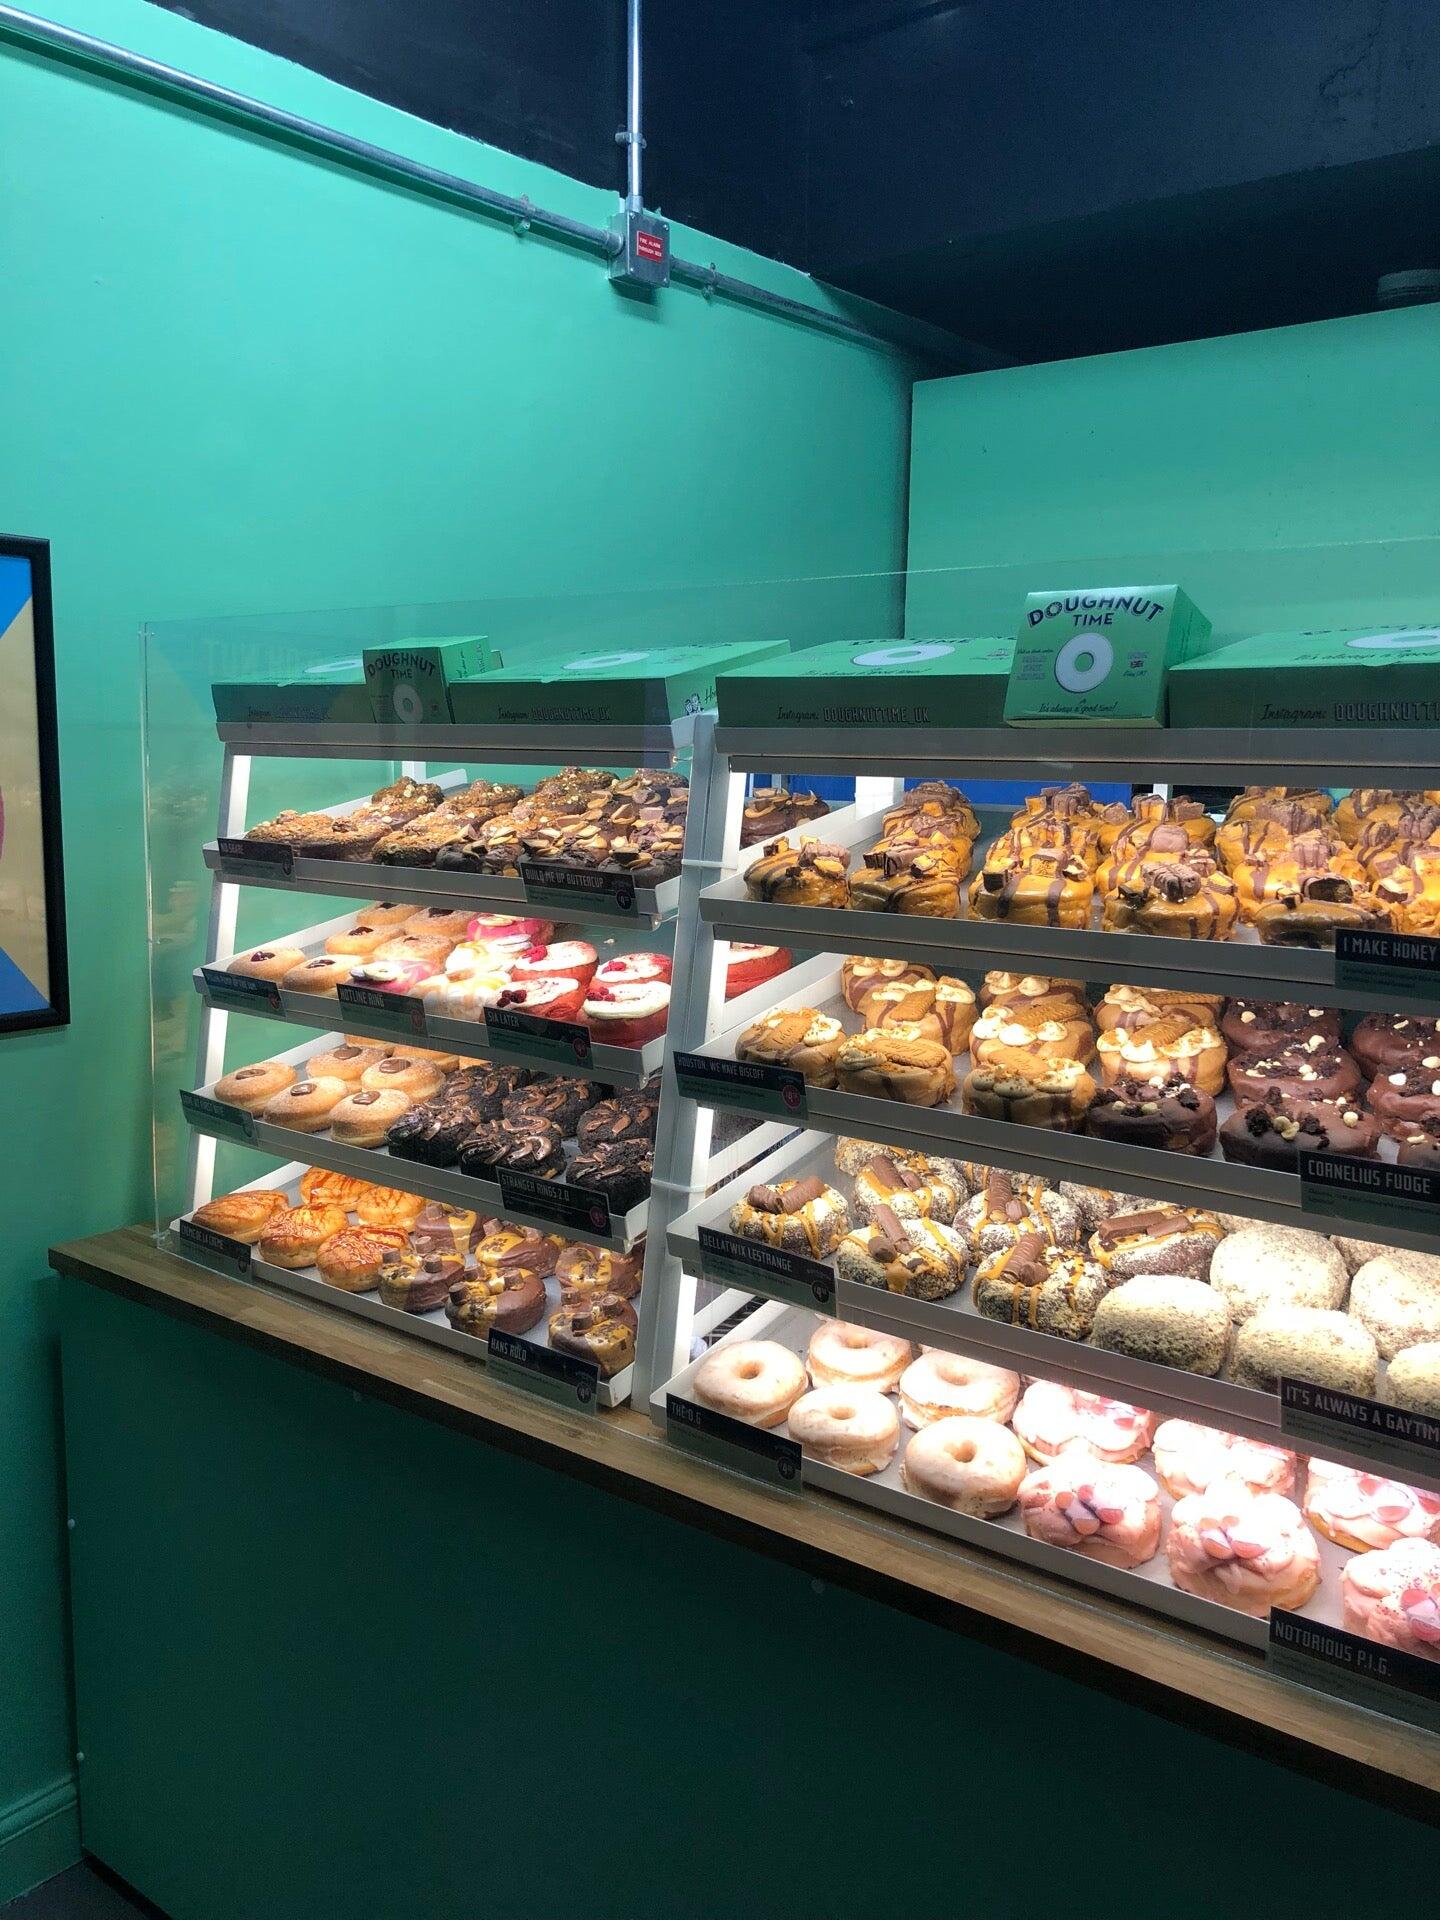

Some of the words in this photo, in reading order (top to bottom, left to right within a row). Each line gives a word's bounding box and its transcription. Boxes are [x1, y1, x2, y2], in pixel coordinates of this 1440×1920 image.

[1027, 595, 1164, 628] DOUGHNUT
[1073, 613, 1114, 627] TIME
[367, 652, 436, 677] DOUGHNUT
[391, 668, 413, 679] TIME
[567, 874, 604, 889] BUTTERCUP
[1343, 937, 1348, 952] I
[1352, 938, 1388, 957] MAKE
[1392, 941, 1438, 961] HONEY
[499, 1012, 520, 1028] LATER
[710, 1062, 720, 1073] WE
[501, 1174, 536, 1193] STRANGER
[1308, 1160, 1381, 1186] CORNELIUS
[1385, 1172, 1431, 1194] FUDGE
[703, 1234, 746, 1258] BELLATWIX
[748, 1247, 793, 1273] LESTRANGE
[491, 1337, 509, 1355] HANS
[1286, 1385, 1310, 1405] IT'S
[1314, 1394, 1367, 1422] ALWAYS
[1372, 1409, 1382, 1426] A
[1275, 1620, 1353, 1662] NOTORIOUS
[1357, 1650, 1392, 1678] P.I.G.
